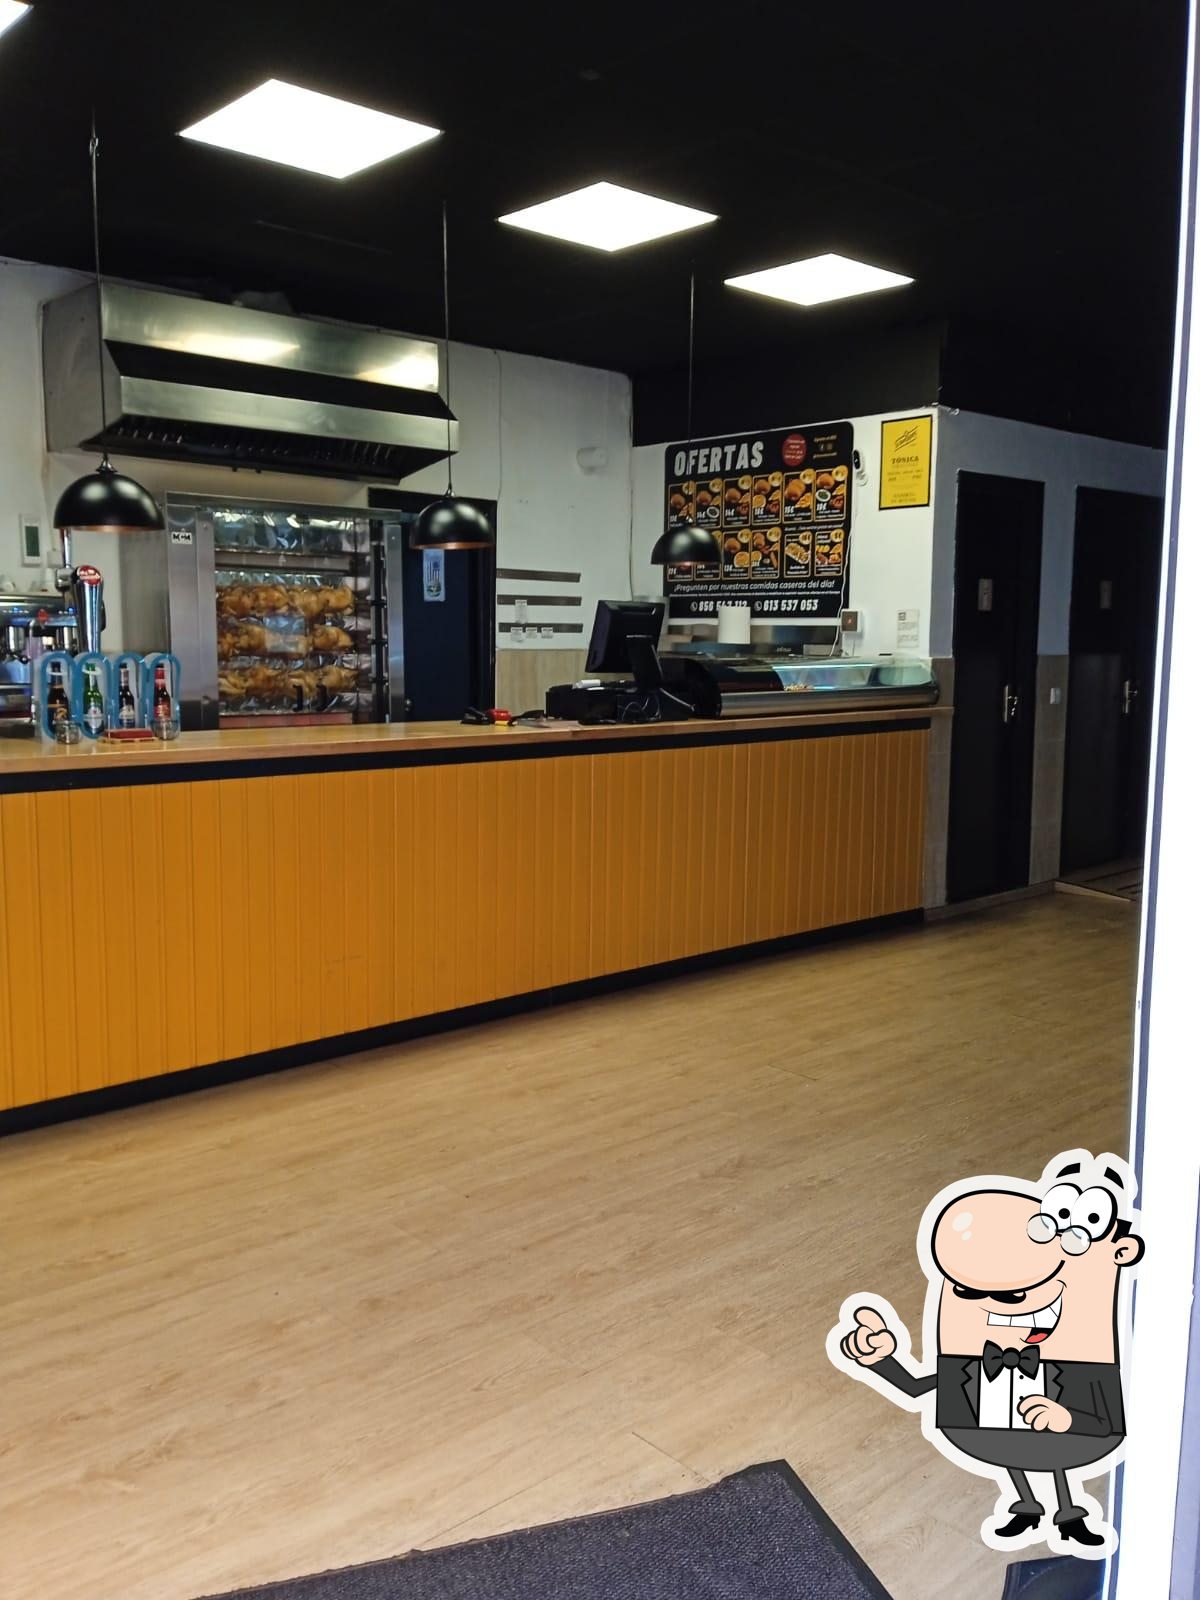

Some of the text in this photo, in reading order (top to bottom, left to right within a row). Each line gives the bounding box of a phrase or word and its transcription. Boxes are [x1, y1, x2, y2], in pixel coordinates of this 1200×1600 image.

[674, 441, 764, 477] OFERTAS
[708, 584, 720, 592] por
[720, 581, 749, 590] nuestras
[749, 581, 779, 590] comidas
[779, 580, 806, 589] caseras
[806, 580, 819, 589] del
[780, 599, 799, 611] 537
[800, 598, 819, 611] 053
